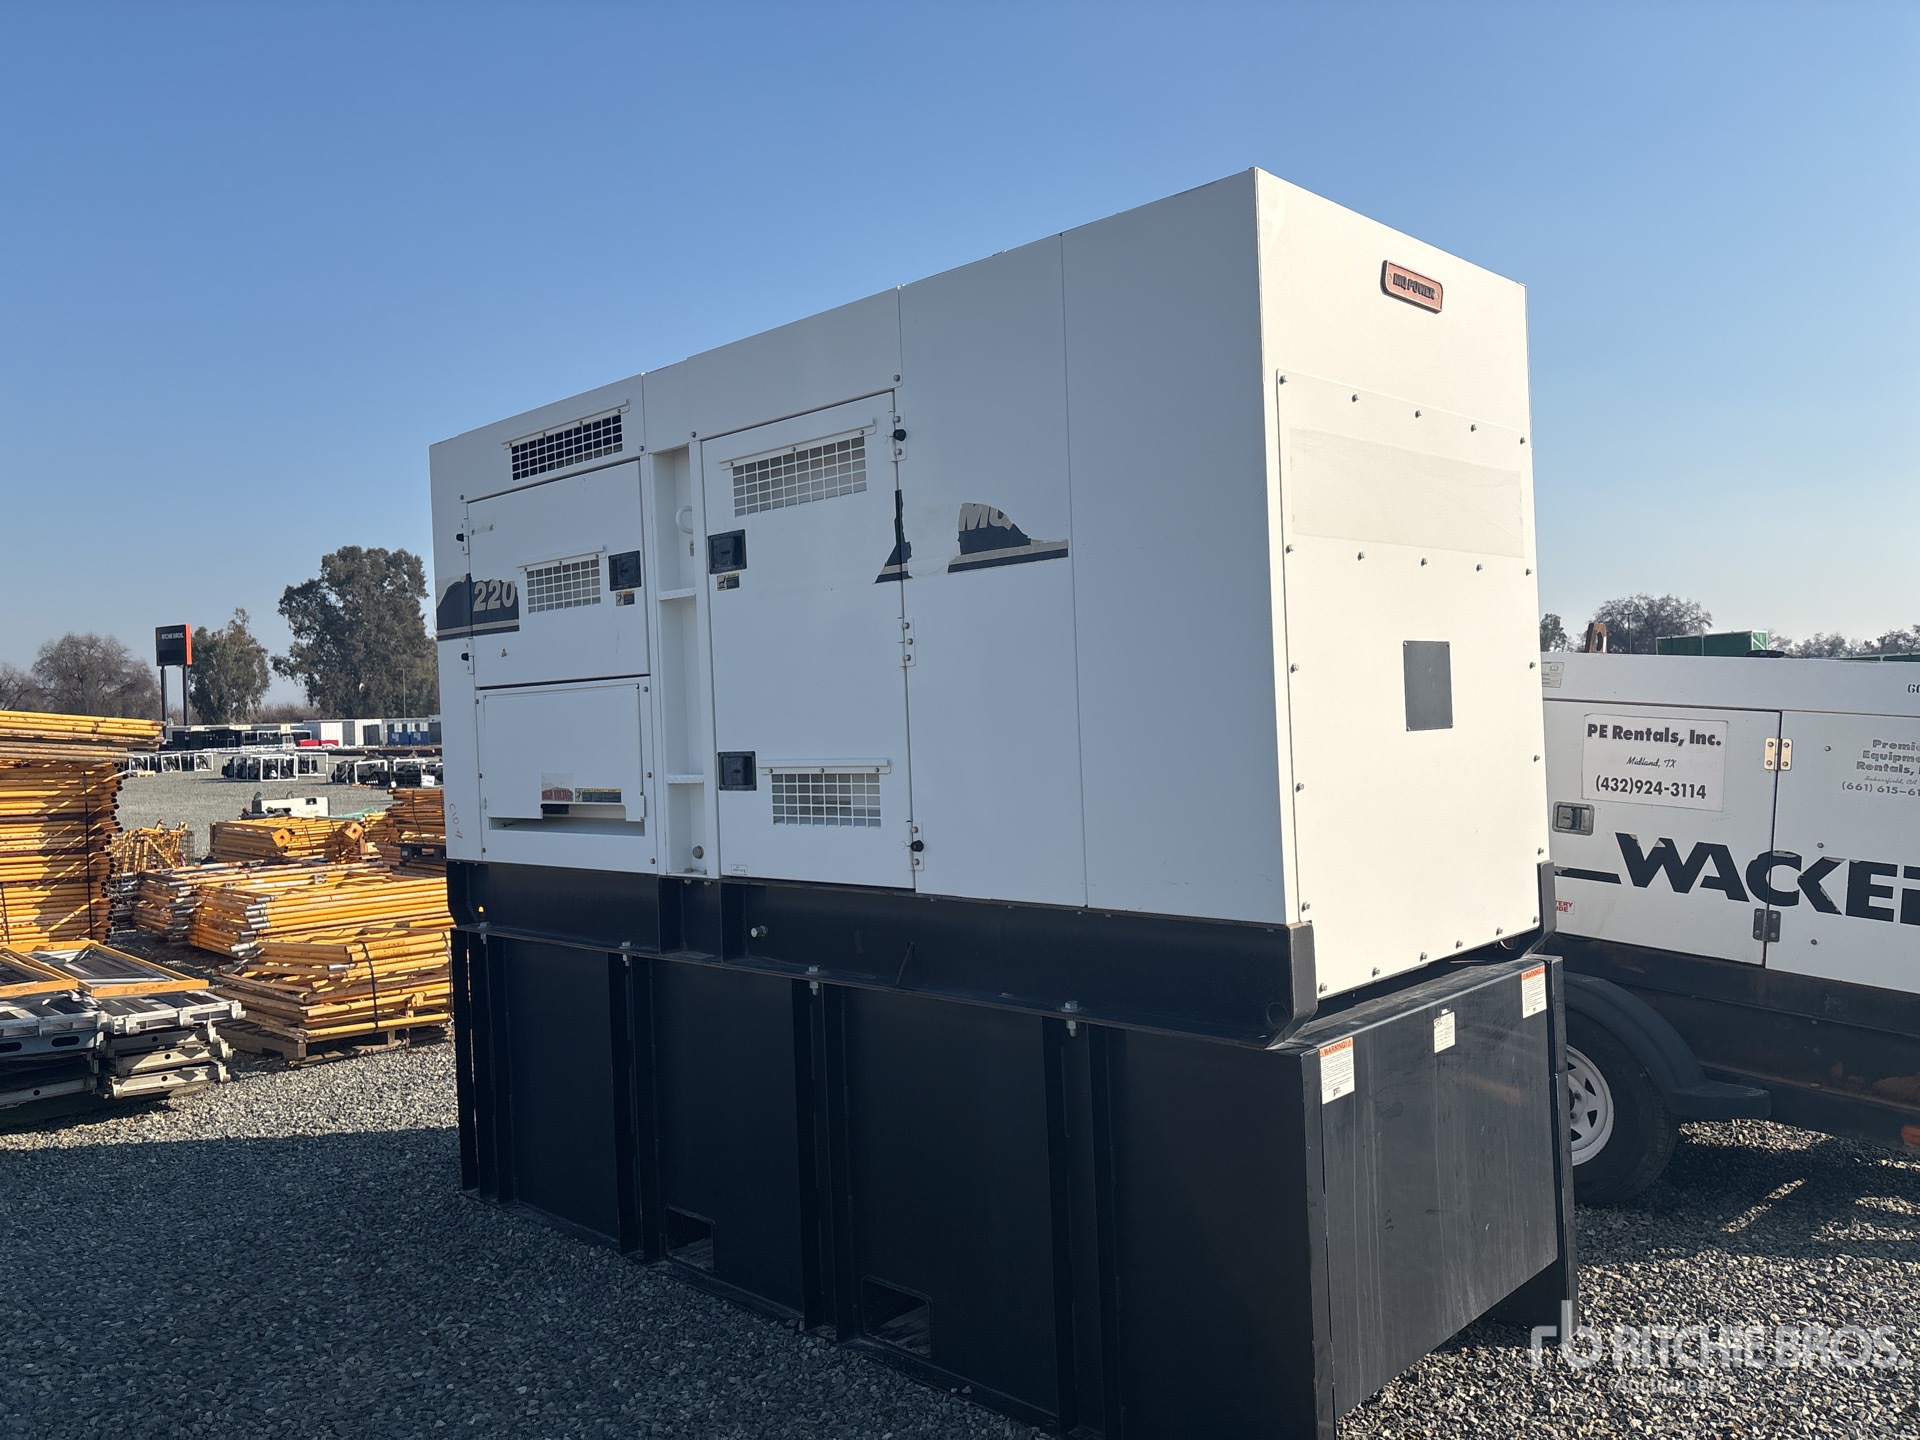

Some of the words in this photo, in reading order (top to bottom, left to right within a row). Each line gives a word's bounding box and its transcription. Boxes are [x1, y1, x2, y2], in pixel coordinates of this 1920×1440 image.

[1392, 272, 1408, 291] MQ
[1407, 278, 1436, 301] POWER
[473, 579, 516, 612] 220
[1587, 724, 1608, 739] PE
[1612, 725, 1685, 746] Rentals,
[1689, 729, 1721, 747] Inc.
[1626, 756, 1661, 768] Midland,
[1663, 758, 1677, 769] TX
[1856, 761, 1914, 776] Rentals,
[1595, 775, 1707, 800] (432)924-3114
[1841, 780, 1873, 793] (661)
